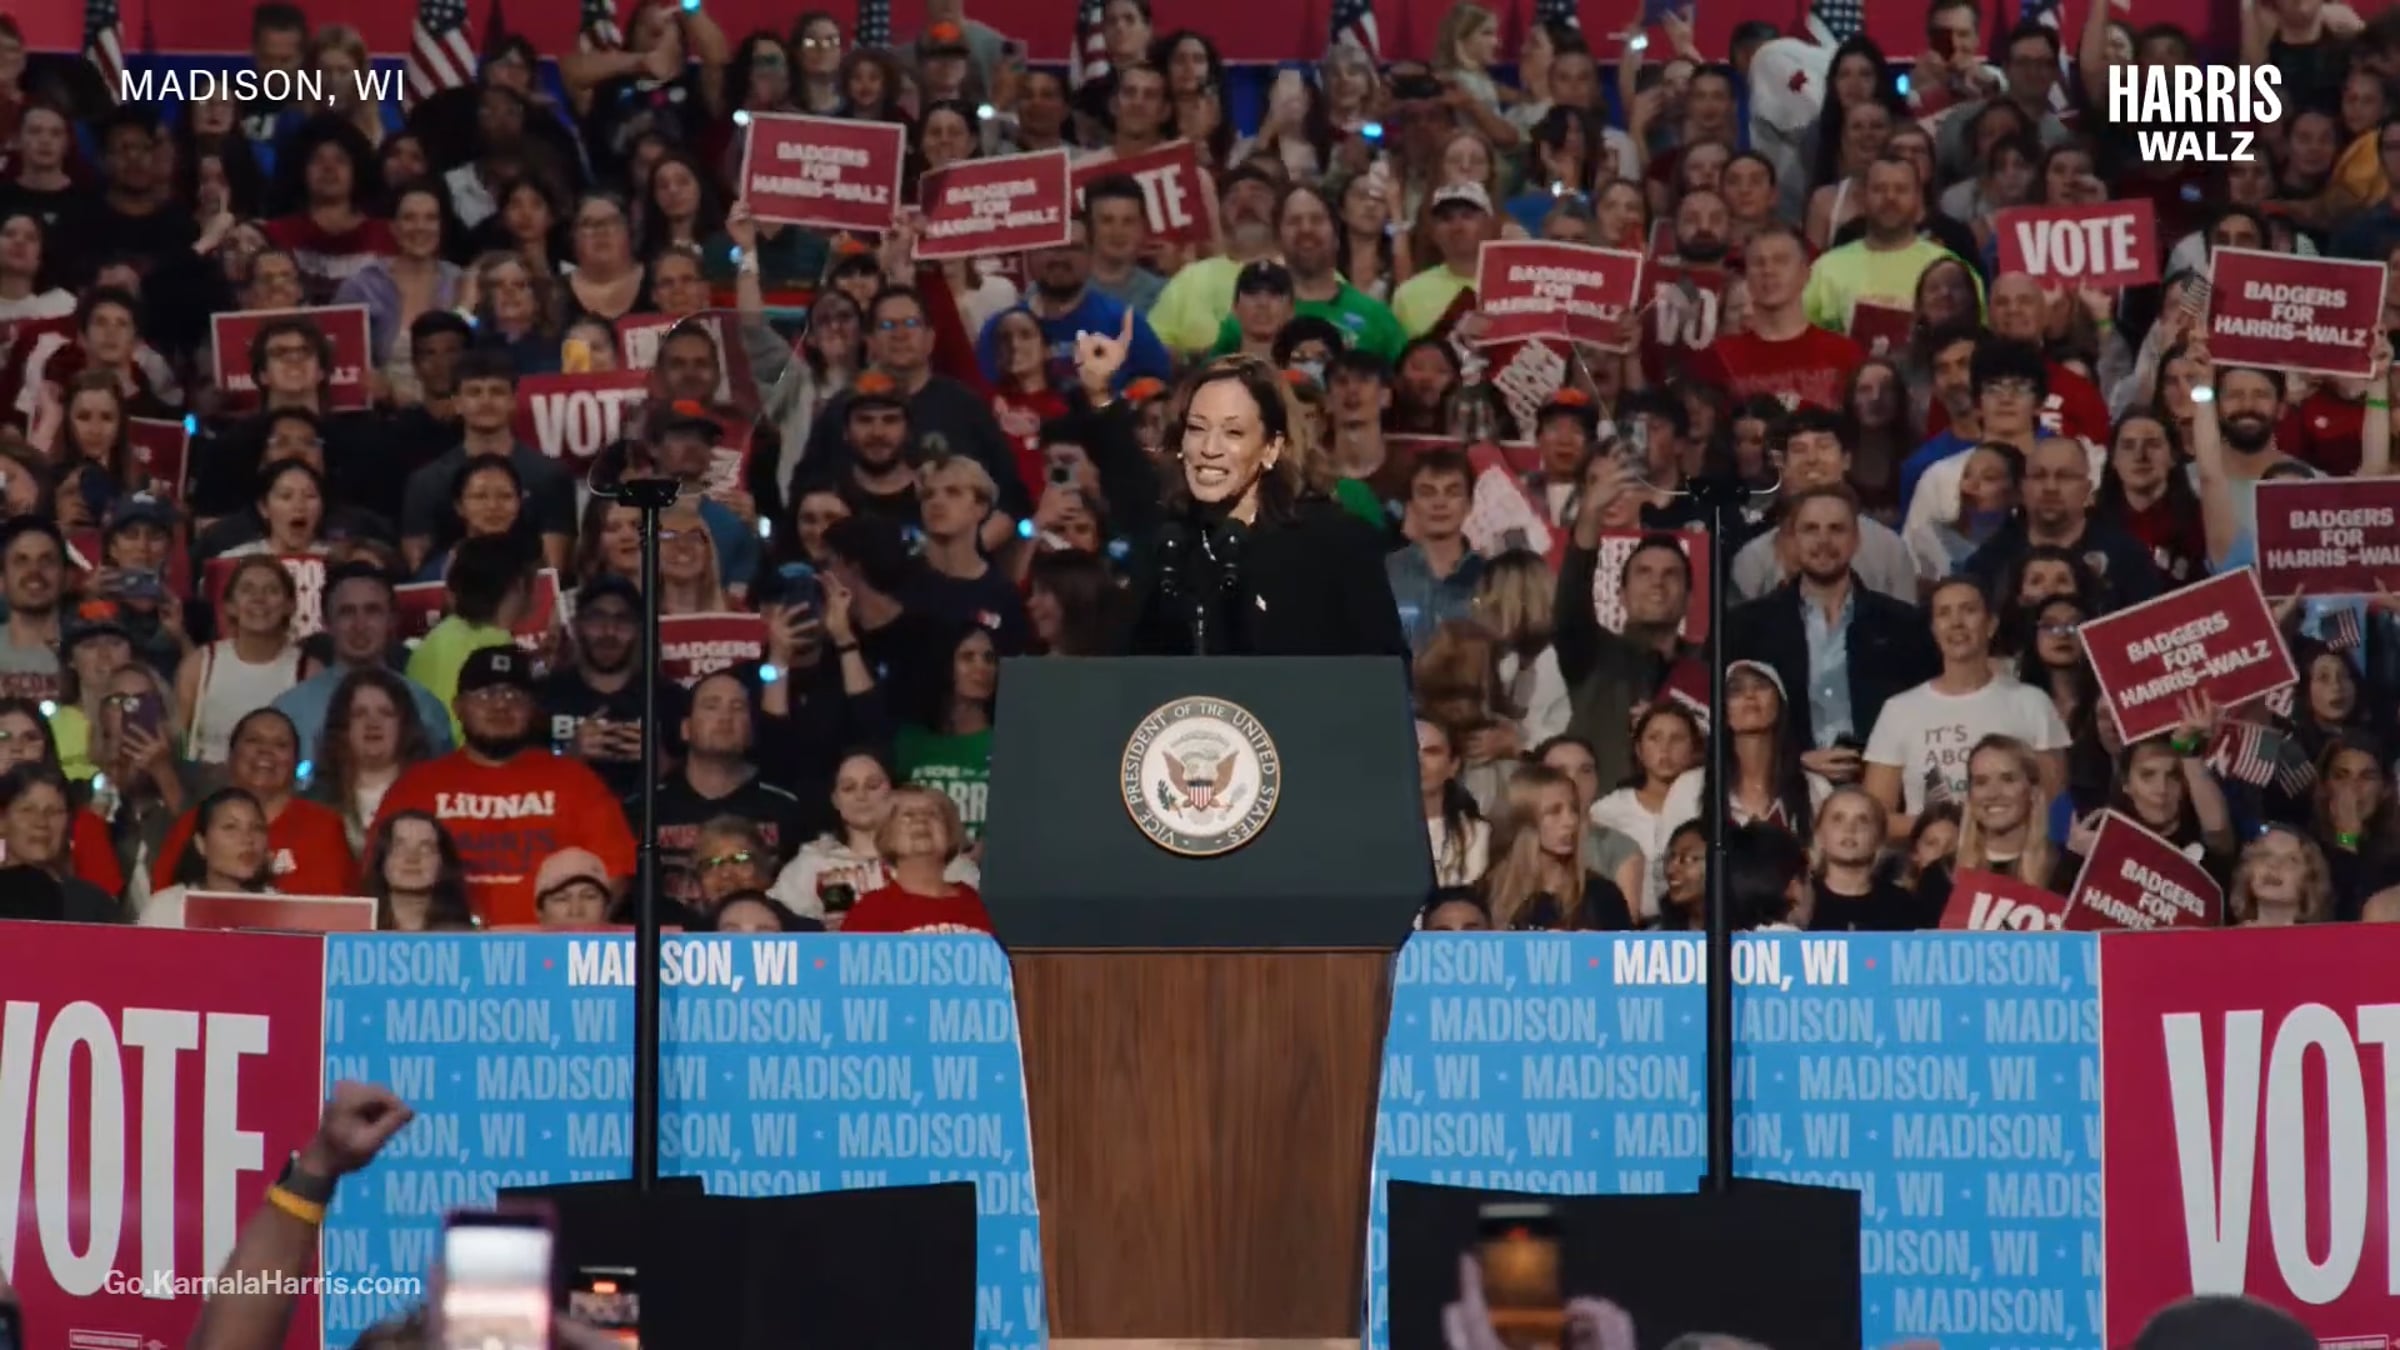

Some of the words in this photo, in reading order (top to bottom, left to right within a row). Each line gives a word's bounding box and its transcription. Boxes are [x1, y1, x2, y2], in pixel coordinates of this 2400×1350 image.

[2015, 215, 2139, 277] VOTE
[2244, 280, 2347, 308] BADGERS
[2271, 303, 2315, 323] FOR
[2214, 314, 2368, 347] HARRIS-WALZ
[2289, 507, 2394, 529] BADGERS
[2320, 528, 2364, 547] FOR
[2267, 545, 2400, 570] HARRIS-WAL
[2126, 610, 2230, 663] BADGERS
[2162, 642, 2207, 671] FOR
[2119, 639, 2272, 709] HARRIS-WALZ
[1174, 704, 1192, 717] OF
[1200, 704, 1225, 717] THE
[1924, 724, 1968, 744] IT'S
[1126, 712, 1167, 804] PRESIDENT
[1232, 711, 1276, 775] UNITED
[436, 791, 556, 819] LiUNA!
[1139, 810, 1175, 845] VICE
[1228, 785, 1275, 842] STATES
[2121, 858, 2204, 917] BADGERS
[2139, 891, 2178, 925] FOR
[328, 941, 471, 992] ADISON,
[480, 941, 526, 985] WI
[568, 940, 744, 992] MASON,
[752, 940, 798, 986] WI
[839, 941, 1010, 992] MADISON,
[1398, 940, 1517, 991] DISON,
[1526, 940, 1572, 984] WI
[1614, 939, 1794, 992] MADION,
[1801, 939, 1848, 985] WI
[1891, 940, 2073, 993] MADISON,
[385, 999, 560, 1049] MADISON,
[572, 999, 616, 1042] WI
[660, 998, 832, 1048] MADISON,
[843, 998, 887, 1042] WI
[1430, 997, 1608, 1048] MADISON,
[1618, 998, 1664, 1042] WI
[1732, 998, 1886, 1049] ADISON,
[1896, 999, 1941, 1043] WI
[1986, 999, 2099, 1044] MADIS
[390, 1056, 435, 1100] WI
[476, 1056, 633, 1100] MADISON
[663, 1056, 707, 1100] WI
[749, 1056, 923, 1106] MADISON,
[933, 1056, 978, 1100] WI
[1434, 1055, 1480, 1100] WI
[1522, 1056, 1700, 1106] MADISON,
[1799, 1056, 1981, 1108] MADISON,
[1990, 1057, 2036, 1101] WI
[480, 1113, 525, 1157] WI
[567, 1112, 742, 1164] MASON,
[752, 1113, 797, 1157] WI
[838, 1113, 1014, 1164] MADISON,
[1377, 1112, 1518, 1164] ADISON,
[1526, 1112, 1572, 1157] WI
[1615, 1113, 1794, 1165] MADION,
[1803, 1113, 1850, 1158] WI
[1892, 1114, 2075, 1166] MADISON,
[2162, 1002, 2400, 1304] VOT
[1897, 1172, 1944, 1217] WI
[1986, 1172, 2101, 1218] MADIS
[389, 1228, 434, 1272] WI
[1861, 1230, 1981, 1282] DISON,
[1990, 1231, 2038, 1275] WI
[1894, 1288, 2078, 1341] MADISON,
